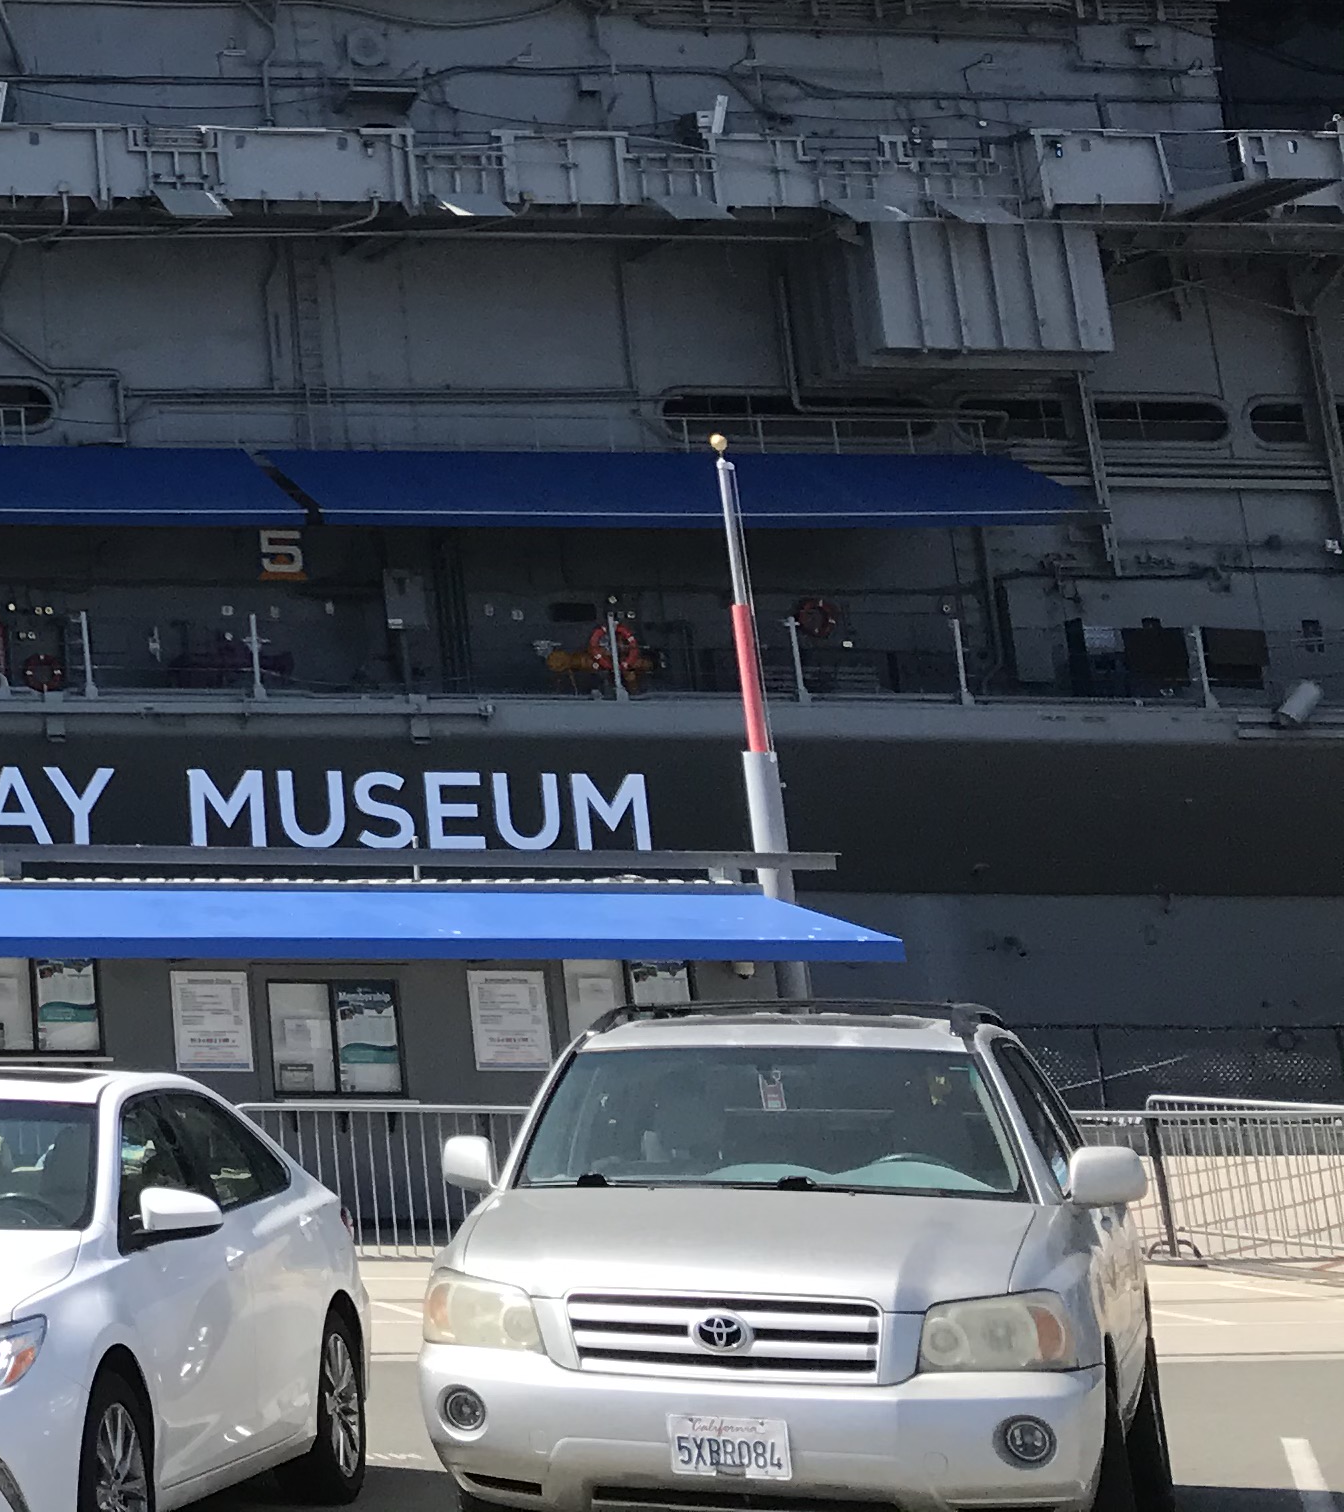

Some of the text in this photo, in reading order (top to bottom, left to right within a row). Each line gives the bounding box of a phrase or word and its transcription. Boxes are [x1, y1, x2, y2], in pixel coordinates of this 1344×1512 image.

[259, 530, 305, 575] 5
[187, 768, 652, 851] MUSEUM
[691, 1417, 762, 1437] California
[676, 1435, 783, 1470] 5XBR084
